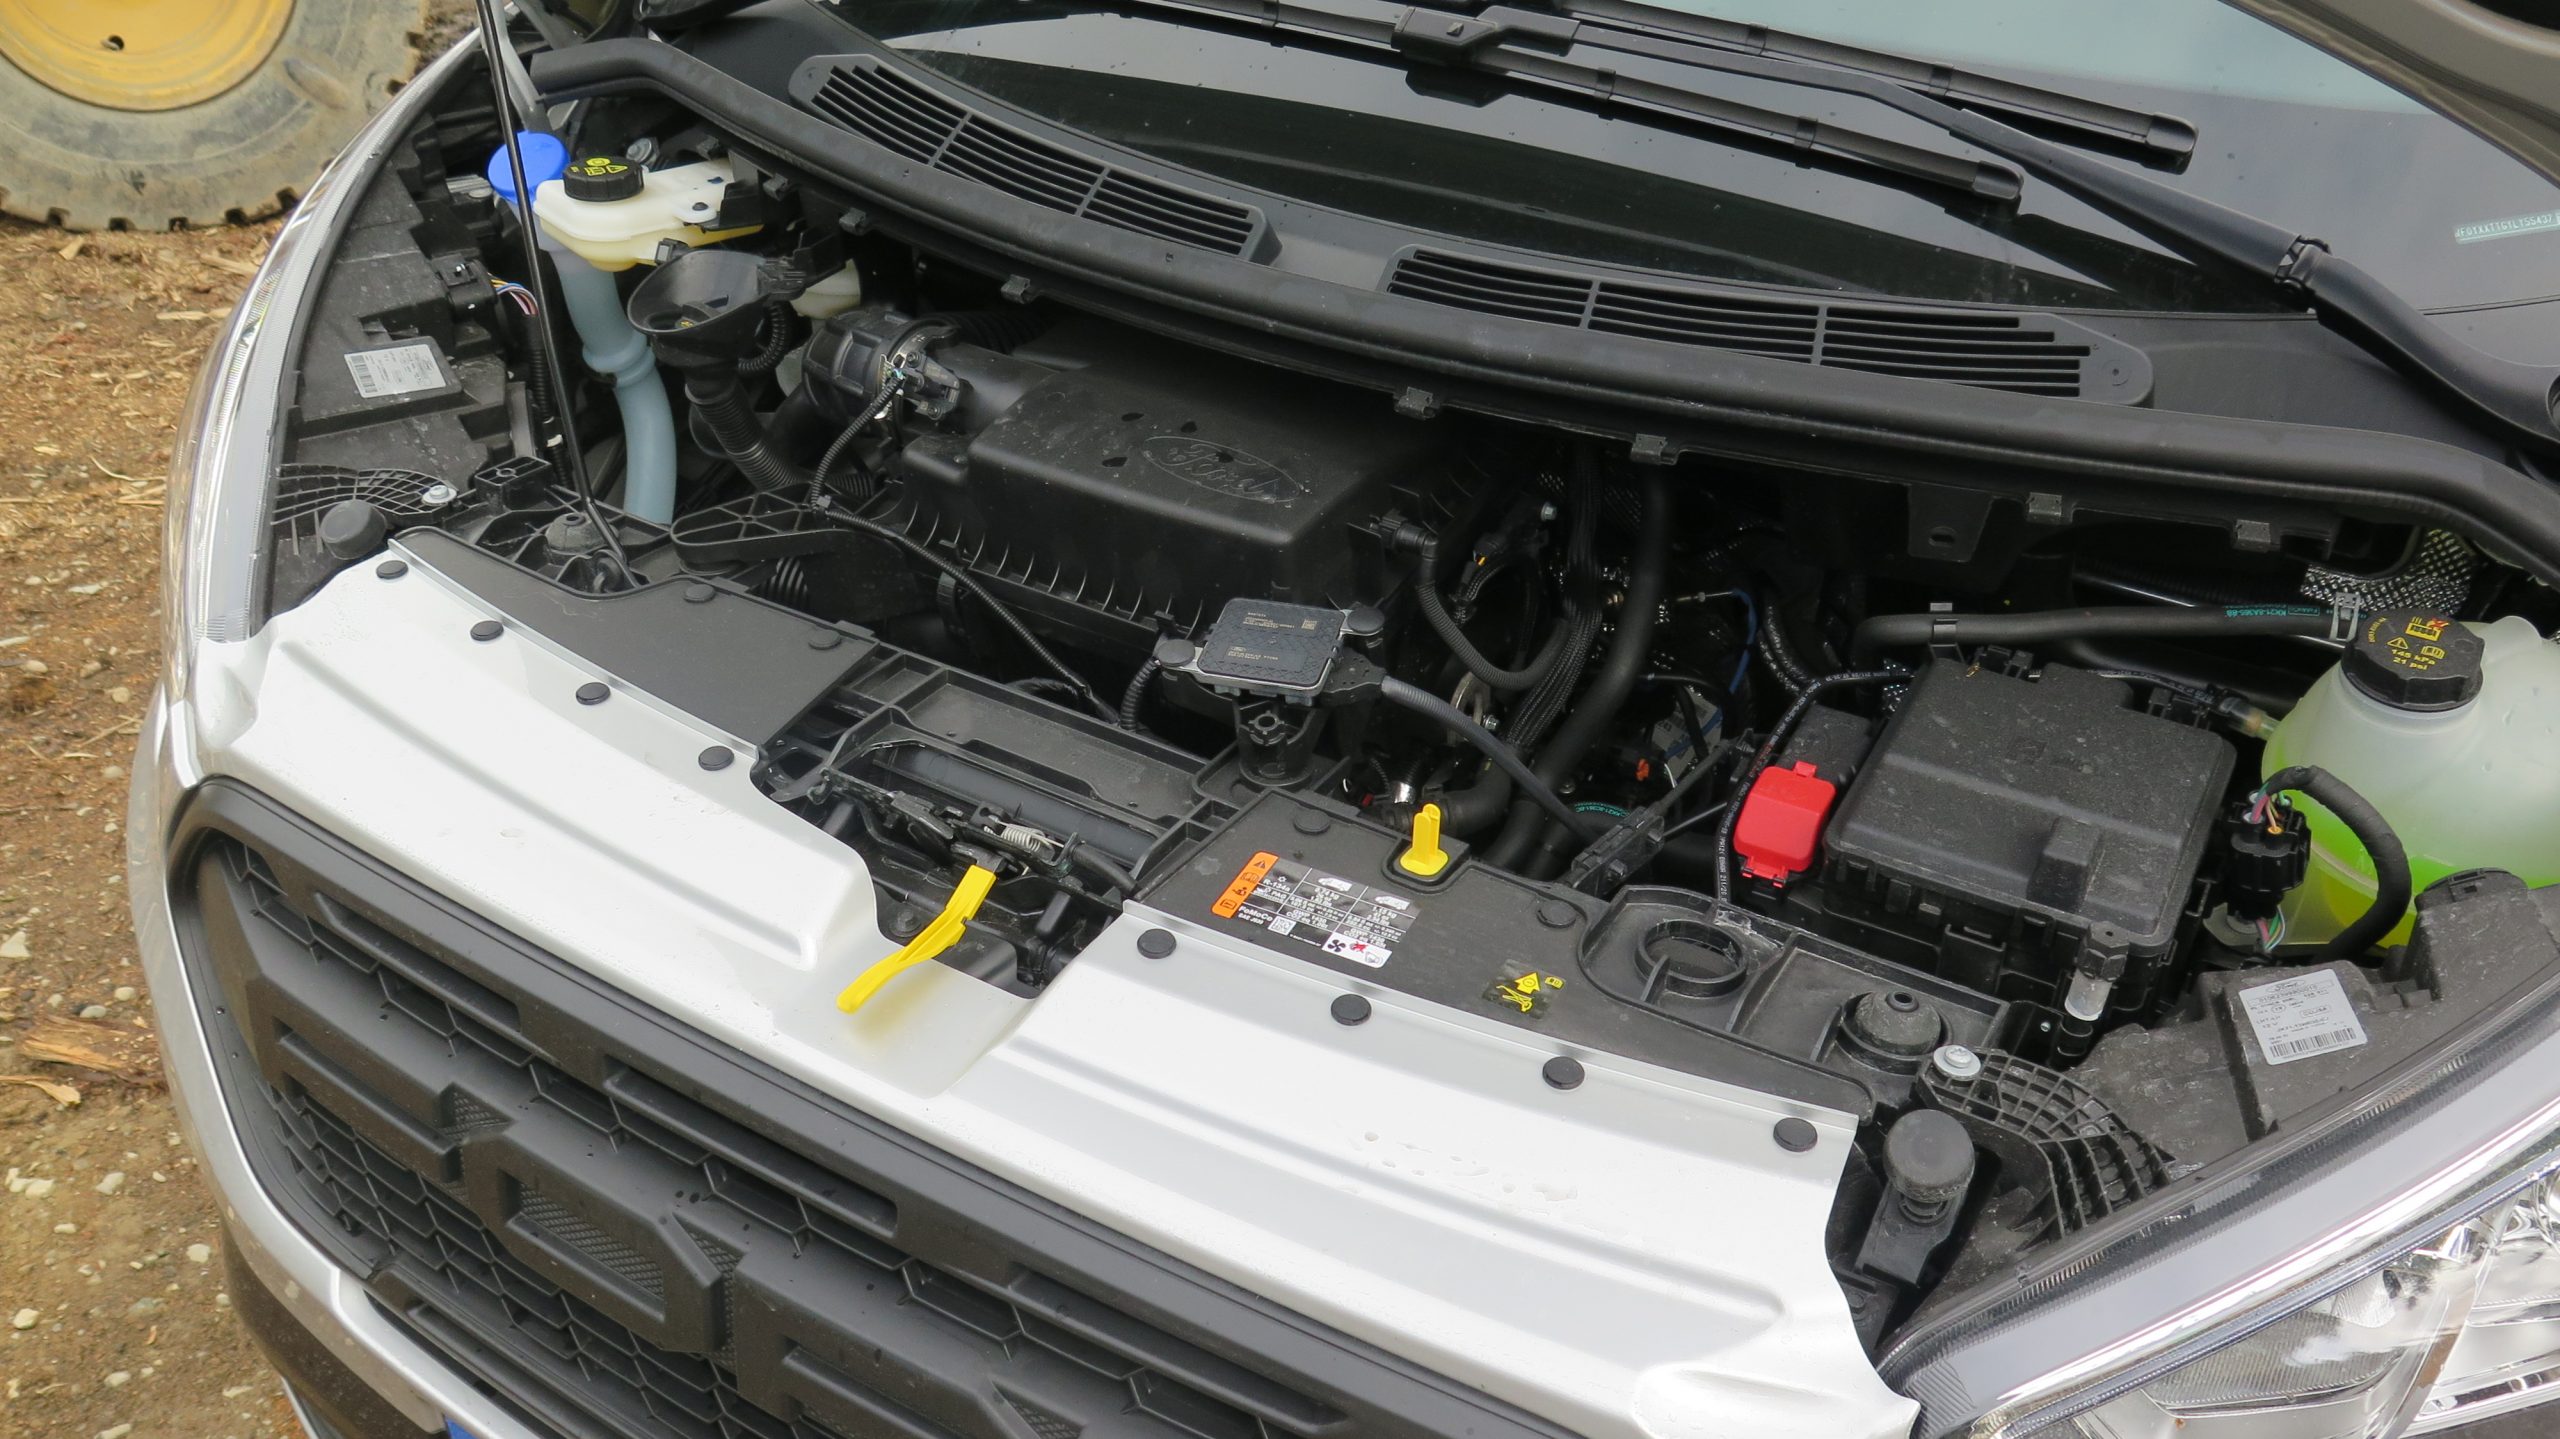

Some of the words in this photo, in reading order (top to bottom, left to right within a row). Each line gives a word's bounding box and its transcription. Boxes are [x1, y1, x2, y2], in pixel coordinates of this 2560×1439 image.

[2391, 649, 2411, 659] 145
[2414, 655, 2435, 665] kPa
[2393, 656, 2407, 665] 21
[2409, 662, 2428, 671] psi
[1262, 878, 1291, 891] R-134a
[1271, 891, 1287, 899] PAG
[1238, 905, 1274, 921] FoMoCo
